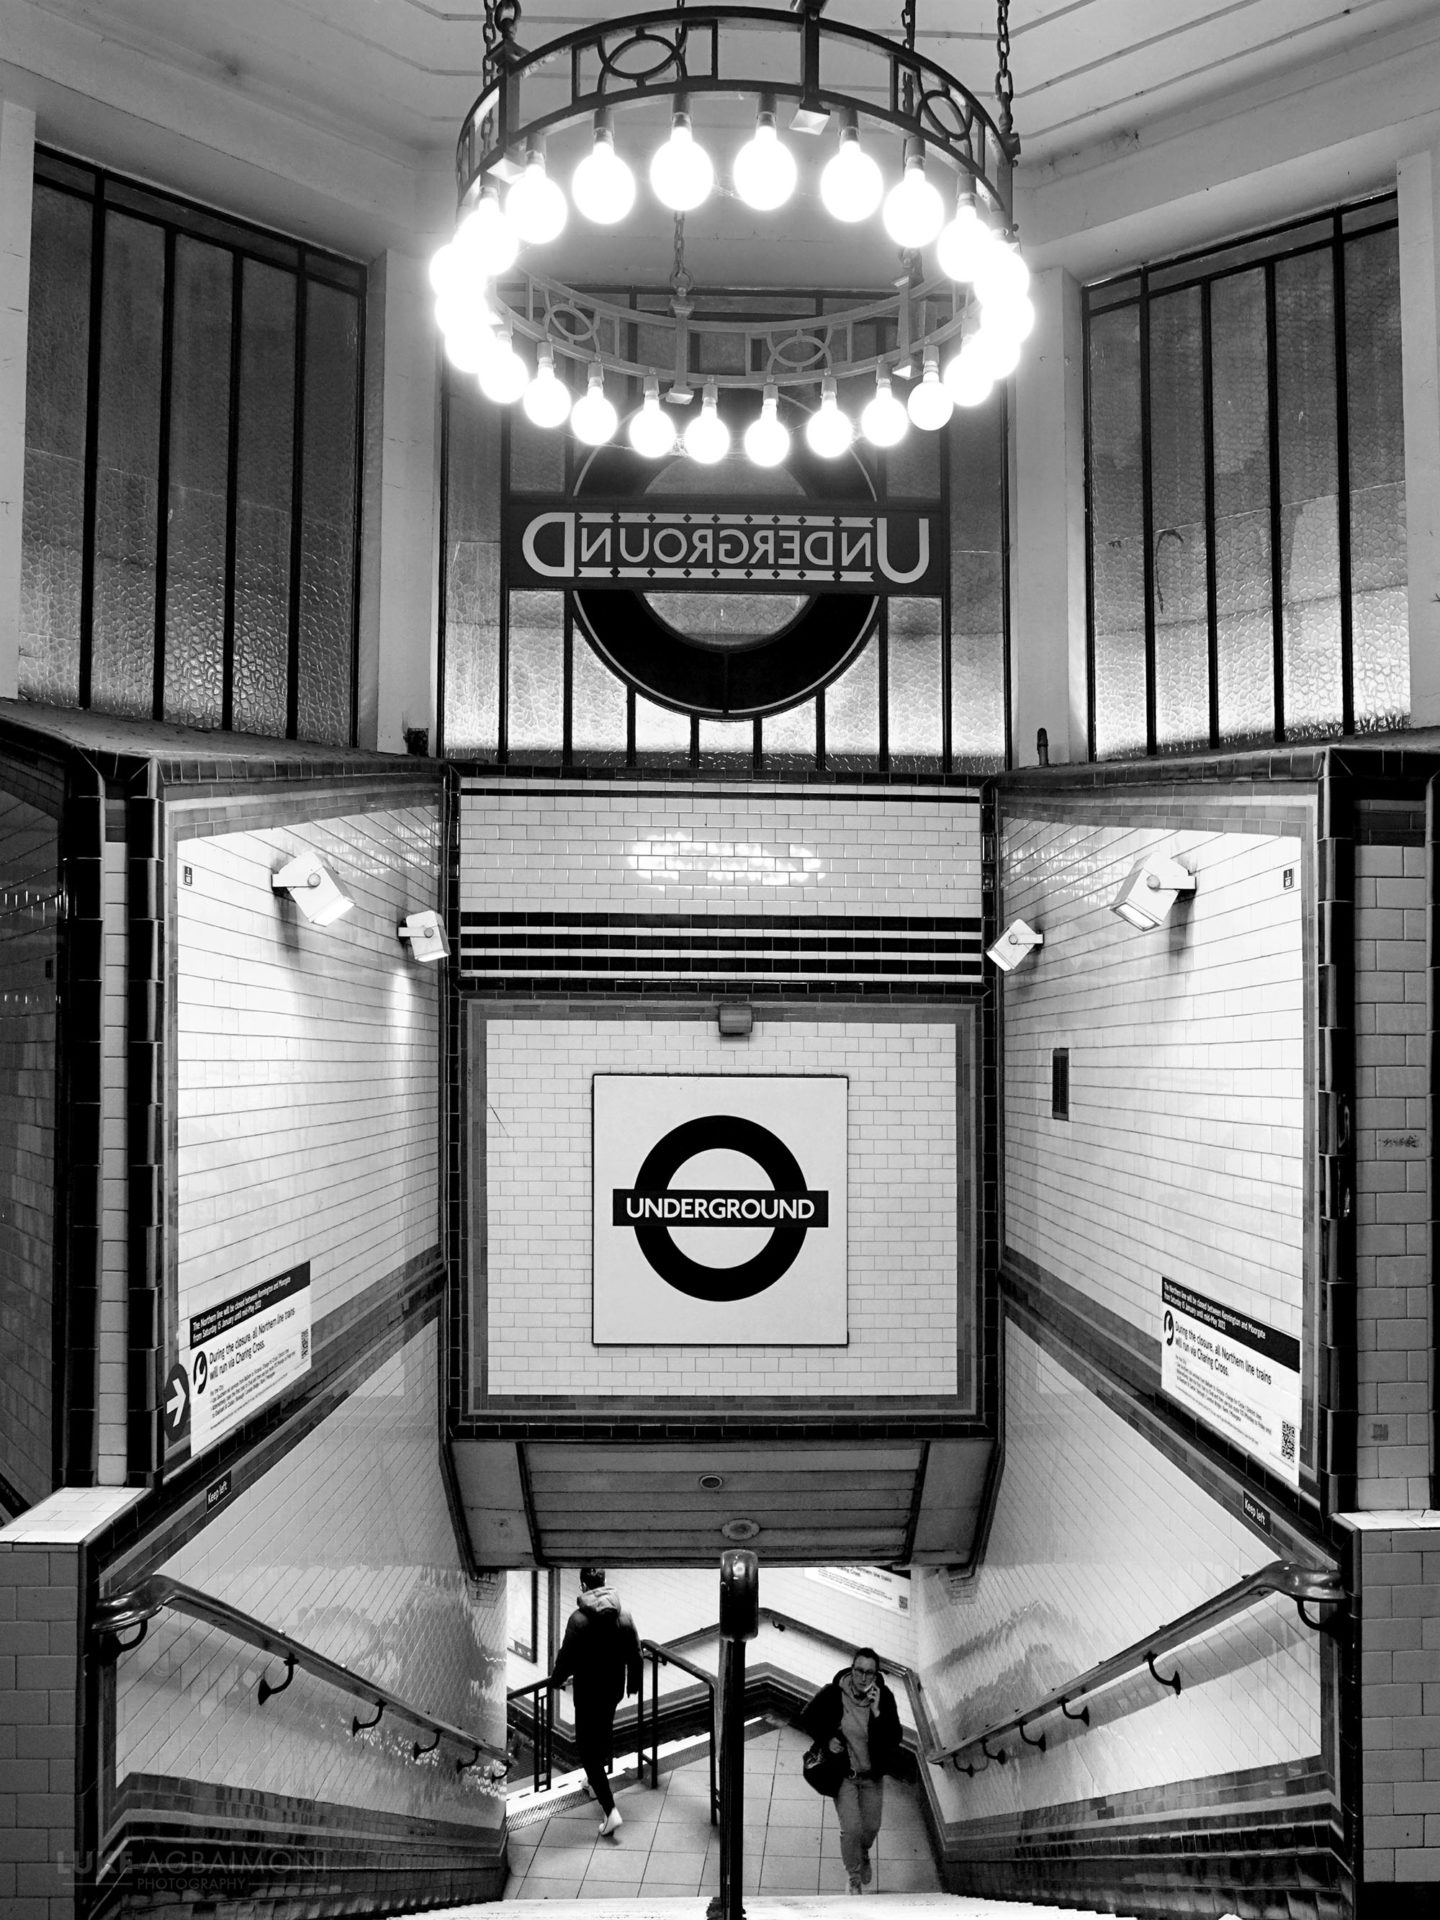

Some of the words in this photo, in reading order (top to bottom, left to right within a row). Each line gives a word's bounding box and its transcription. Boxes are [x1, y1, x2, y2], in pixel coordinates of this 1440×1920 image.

[626, 1197, 815, 1219] UNDERGROUND
[209, 1348, 225, 1364] During
[225, 1343, 234, 1355] the
[258, 1318, 276, 1334] Northern
[276, 1314, 284, 1324] line
[284, 1307, 295, 1320] trains
[209, 1366, 218, 1380] will
[219, 1362, 227, 1374] run
[235, 1347, 252, 1364] Charing
[252, 1340, 265, 1354] Cross.
[1175, 1321, 1188, 1340] During
[1188, 1330, 1196, 1342] the
[1221, 1347, 1244, 1367] Northern
[1245, 1360, 1255, 1375] line
[1256, 1368, 1271, 1385] trains
[1197, 1348, 1213, 1370] Charing
[1214, 1358, 1228, 1376] Cross.
[208, 1489, 219, 1504] Keep
[219, 1481, 228, 1495] left
[1244, 1498, 1256, 1517] Keep
[1256, 1508, 1266, 1525] left
